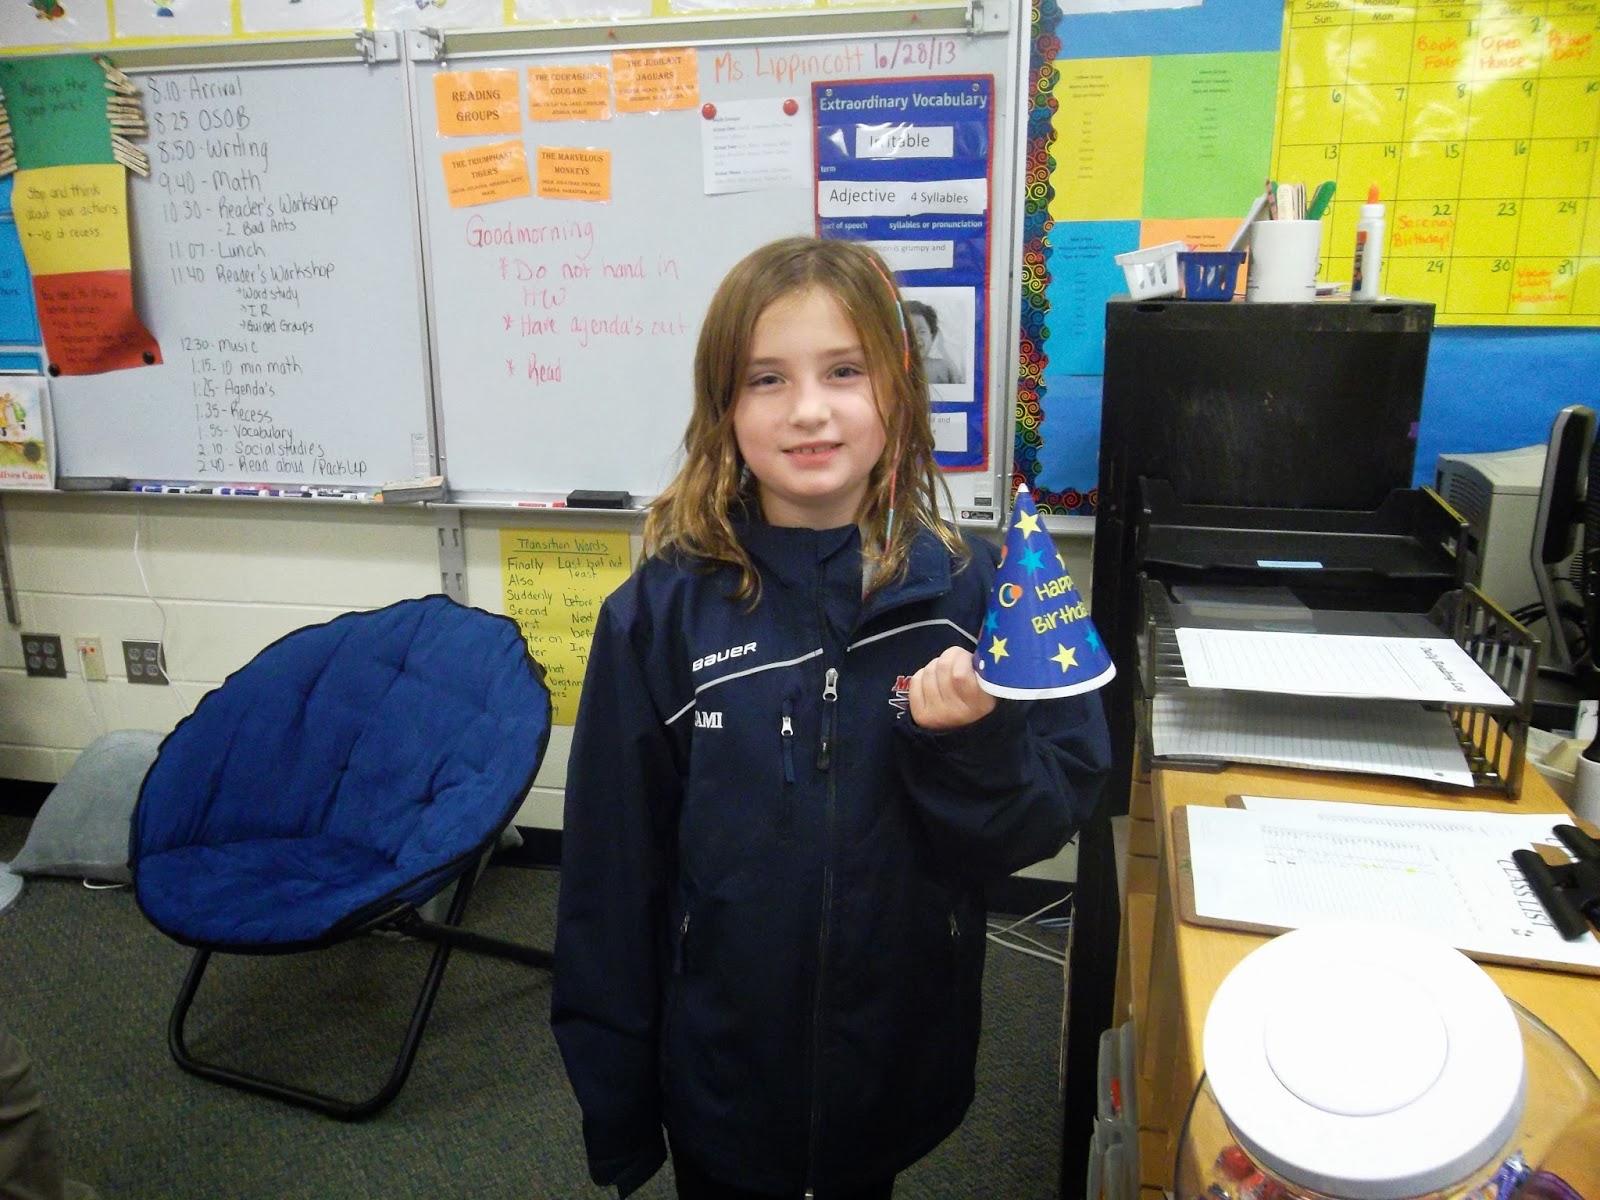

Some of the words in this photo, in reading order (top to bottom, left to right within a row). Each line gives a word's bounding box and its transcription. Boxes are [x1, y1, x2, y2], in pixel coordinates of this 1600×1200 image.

[1314, 15, 1332, 24] Sun
[1372, 13, 1394, 21] Mon
[1439, 10, 1461, 19] Tues
[1481, 36, 1521, 51] Open
[755, 46, 864, 84] Lippincott
[535, 73, 548, 81] THE
[550, 71, 602, 82] COURAGEOUS
[636, 72, 674, 81] JAGUARS
[189, 75, 243, 99] Arrival
[550, 87, 587, 95] COUGARS
[1395, 87, 1405, 101] 7
[1457, 82, 1467, 98] 8
[1522, 80, 1533, 98] 9
[452, 89, 501, 102] READING
[819, 96, 908, 112] Extraordinary
[912, 93, 988, 108] Vocabulary
[1332, 89, 1342, 103] 6
[199, 105, 250, 131] OSOB
[456, 110, 500, 122] GROUPS
[870, 133, 930, 148] Iritable
[1575, 140, 1590, 153] 17
[206, 133, 269, 173] Writing
[1324, 145, 1338, 160] 13
[1384, 144, 1396, 158] 14
[1445, 143, 1460, 158] 15
[1514, 142, 1526, 155] 16
[451, 161, 467, 169] THE
[467, 151, 514, 166] TRIUMPHANT
[542, 152, 556, 160] THE
[557, 152, 604, 162] MARVELOUS
[820, 164, 836, 172] term
[213, 169, 260, 191] Math
[70, 184, 100, 198] think
[829, 188, 896, 204] Adjective
[910, 192, 917, 201] 4
[920, 191, 969, 204] Syllables
[219, 195, 274, 219] Reader's
[279, 192, 338, 215] Workshop
[1433, 204, 1451, 216] 22
[1497, 203, 1517, 216] 23
[1558, 201, 1577, 214] 24
[243, 221, 265, 237] Bad
[270, 218, 297, 232] Ants
[844, 221, 868, 230] speech
[889, 221, 921, 230] syllables
[922, 221, 930, 229] or
[932, 220, 983, 230] pronunciation
[218, 241, 266, 258] Lunch
[901, 244, 930, 253] grumpy
[931, 243, 946, 251] and
[216, 263, 266, 283] Reader's
[271, 260, 335, 280] Workshop
[515, 258, 547, 281] Do
[561, 260, 592, 280] not
[602, 256, 646, 279] hand
[657, 253, 680, 280] in
[1427, 260, 1443, 273] 29
[1491, 259, 1510, 272] 30
[1557, 259, 1573, 276] 31
[523, 286, 566, 309] HW
[247, 320, 277, 333] Guided
[280, 319, 314, 335] Groups
[521, 314, 557, 337] Have
[571, 315, 643, 347] agenda's
[651, 312, 689, 336] out
[218, 338, 259, 353] Music
[222, 360, 232, 375] 10
[241, 363, 262, 374] min
[267, 354, 302, 374] math
[528, 353, 562, 386] Read
[224, 379, 275, 401] Agenda's
[230, 402, 273, 423] Recess
[234, 424, 293, 442] Vocabulary
[235, 441, 276, 456] Social
[278, 440, 325, 457] studies
[238, 456, 269, 473] Read
[517, 538, 570, 550] Transition
[574, 538, 608, 552] Words
[507, 556, 544, 575] Finally
[557, 556, 580, 569] Last
[586, 556, 604, 568] but
[609, 556, 622, 568] not
[508, 574, 534, 586] Also
[569, 568, 597, 579] least
[1034, 575, 1075, 601] Happ
[507, 589, 553, 606] Suddenly
[563, 593, 592, 607] before
[509, 604, 548, 616] Second
[571, 611, 594, 624] Next
[548, 635, 562, 644] on
[570, 642, 585, 652] In
